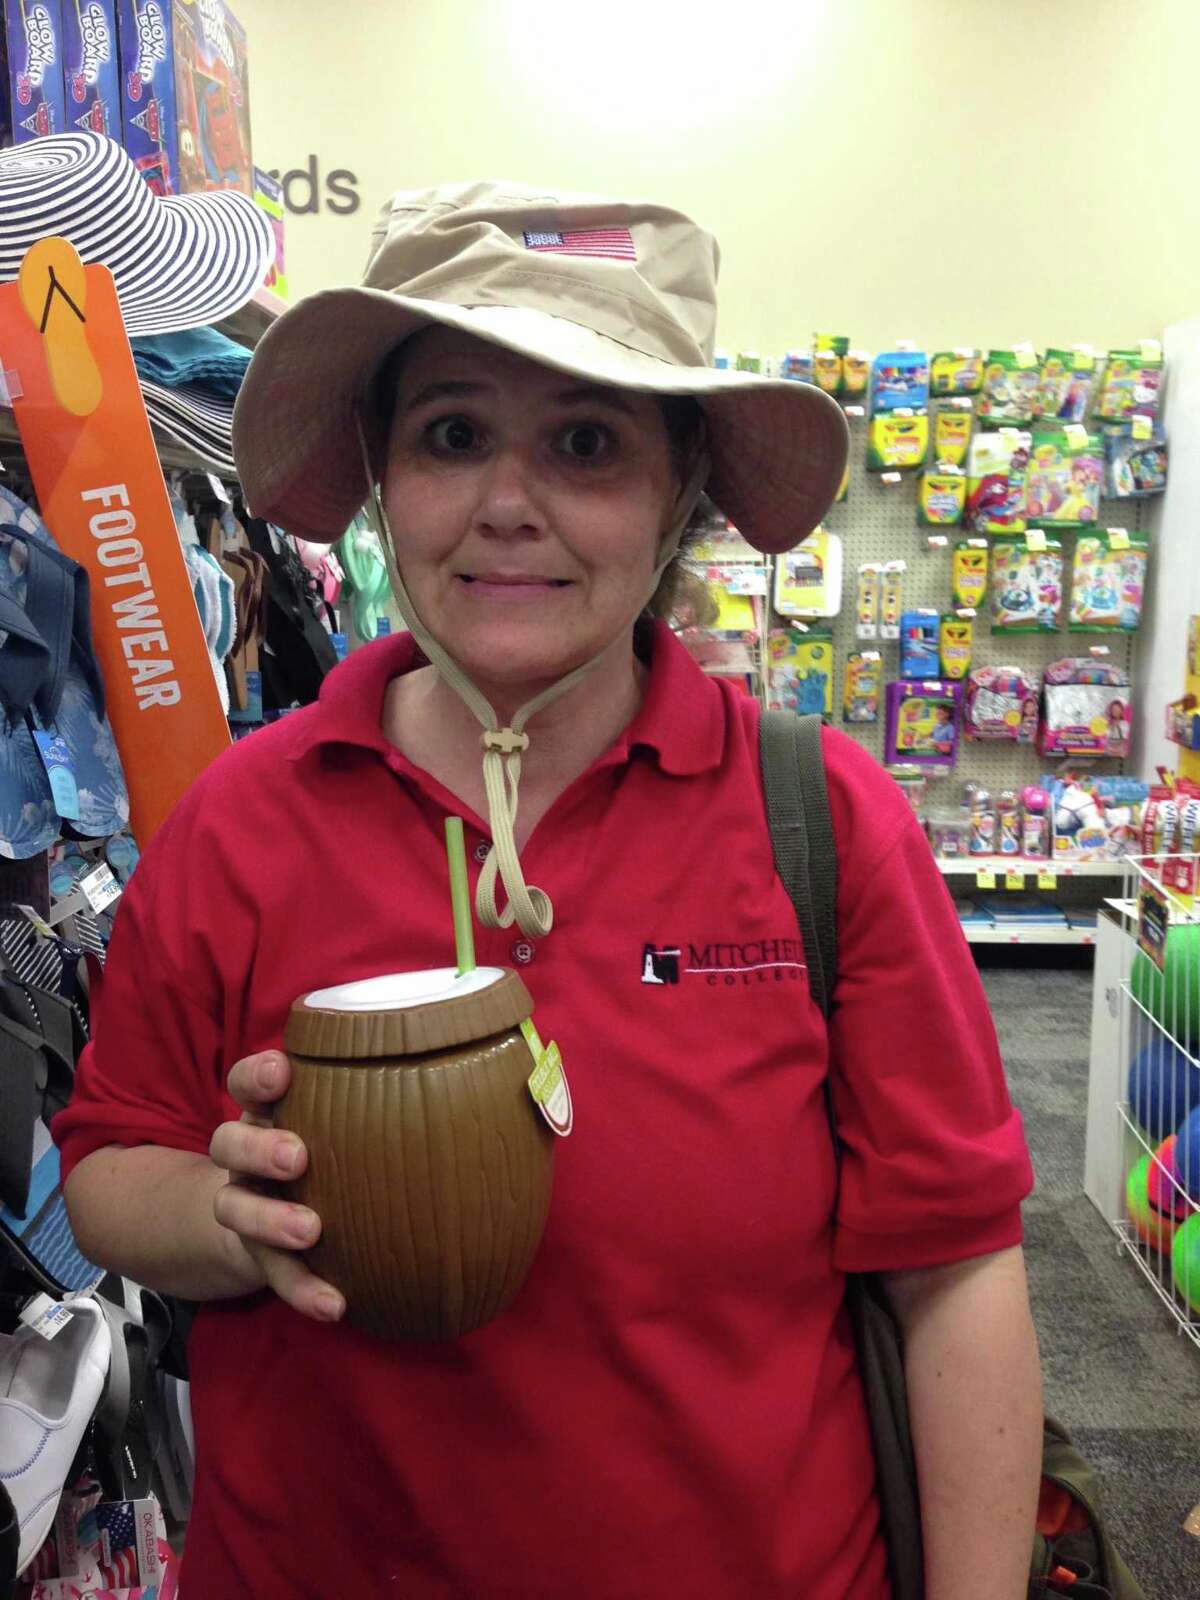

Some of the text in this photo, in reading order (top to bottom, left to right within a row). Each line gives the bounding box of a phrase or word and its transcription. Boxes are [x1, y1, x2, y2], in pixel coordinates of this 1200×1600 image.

[26, 17, 43, 86] BOARD
[33, 5, 55, 65] GLOW
[80, 15, 98, 84] BOARD
[88, 3, 110, 63] GLOW
[137, 13, 154, 83] BOARD
[145, 1, 167, 61] GLOW
[80, 483, 182, 711] FOOTWEAR
[143, 1511, 157, 1575] OKABASH
